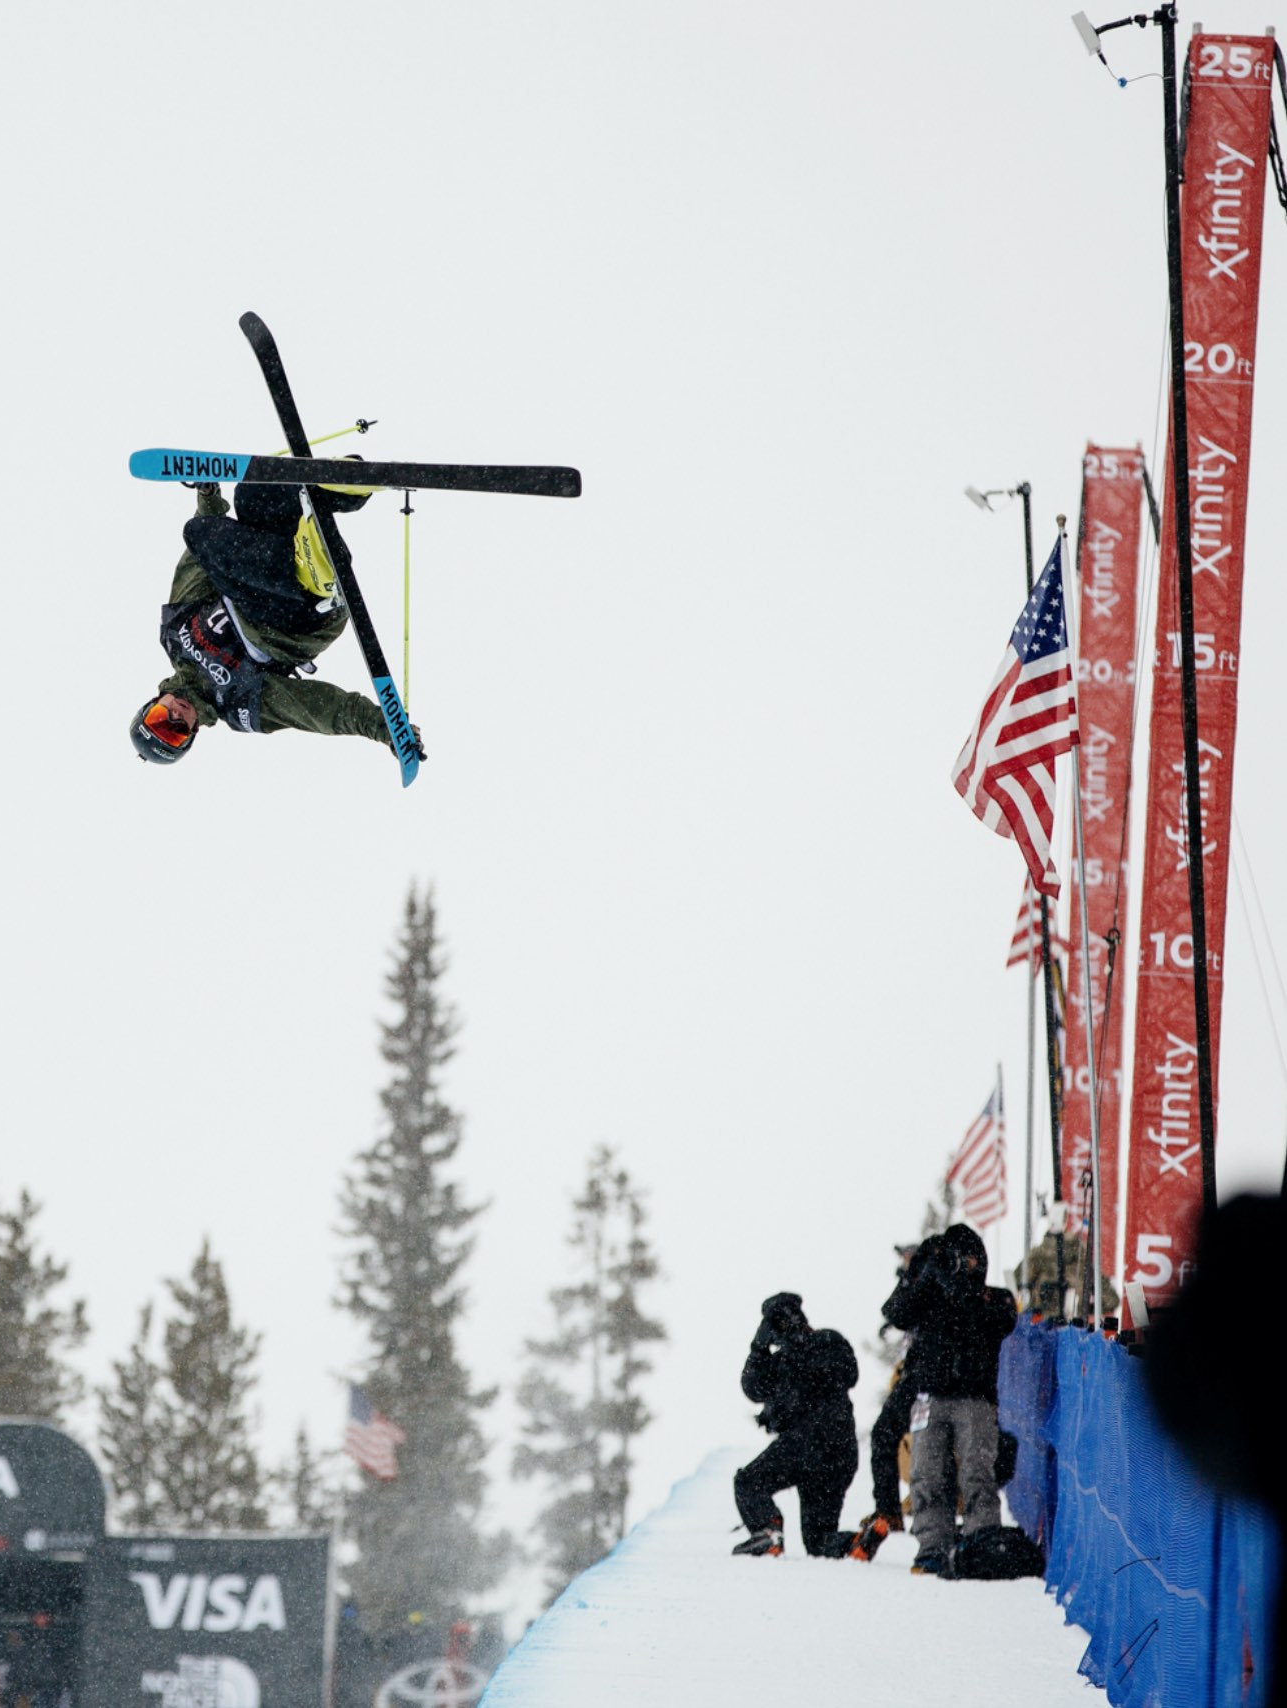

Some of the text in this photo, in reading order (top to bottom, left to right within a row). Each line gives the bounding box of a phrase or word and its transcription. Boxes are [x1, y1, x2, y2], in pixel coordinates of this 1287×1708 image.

[1198, 140, 1255, 281] xfinity
[162, 455, 237, 478] MOMENT
[1188, 435, 1238, 577] xfinity
[1084, 519, 1123, 618] xfinity
[178, 623, 207, 669] TOYOTA
[207, 609, 230, 634] 17
[380, 683, 416, 765] MOMENT
[1080, 722, 1117, 822] xfinity
[1148, 1032, 1200, 1177] xfinity
[1133, 1233, 1197, 1288] 5f
[128, 1571, 287, 1632] VISA
